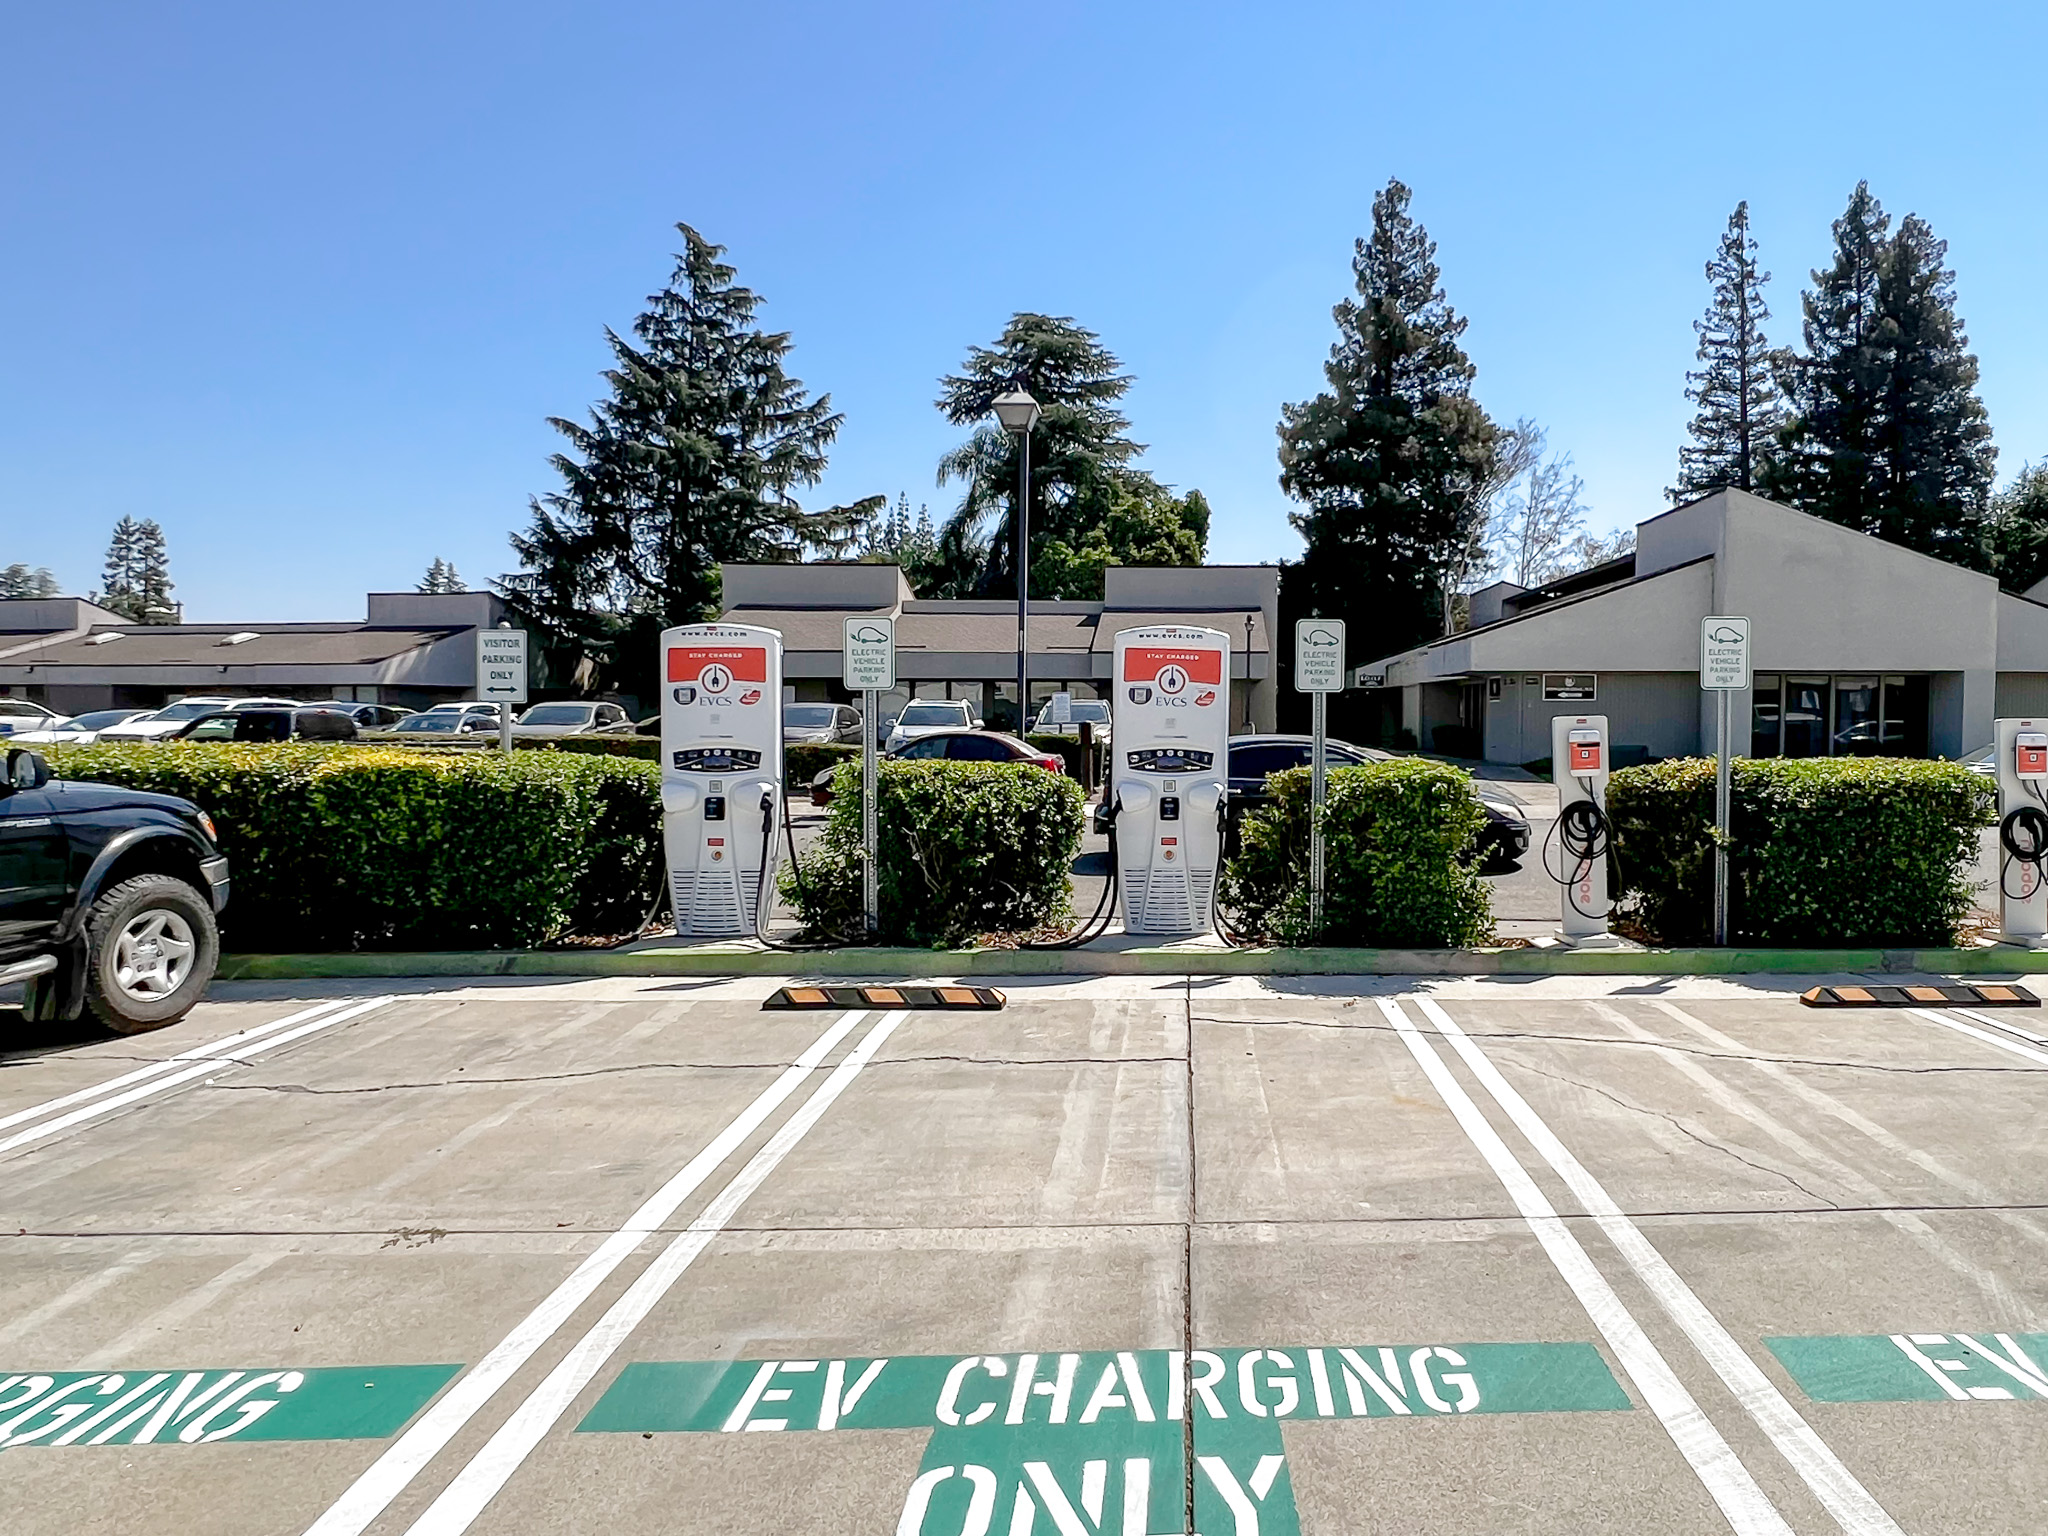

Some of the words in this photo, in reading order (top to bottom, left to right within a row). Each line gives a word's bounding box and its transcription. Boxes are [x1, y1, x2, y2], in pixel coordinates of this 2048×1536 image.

[483, 639, 521, 648] VISITOR
[482, 655, 522, 664] PARKING
[1303, 651, 1337, 659] ELECTRIC
[490, 671, 513, 680] ONLY
[699, 697, 732, 706] EVCS
[1155, 697, 1187, 707] EVCS
[1888, 1333, 2048, 1400] EV
[721, 1359, 889, 1432] EV
[936, 1346, 1480, 1426] CHARGING
[897, 1454, 1284, 1536] ONLY
